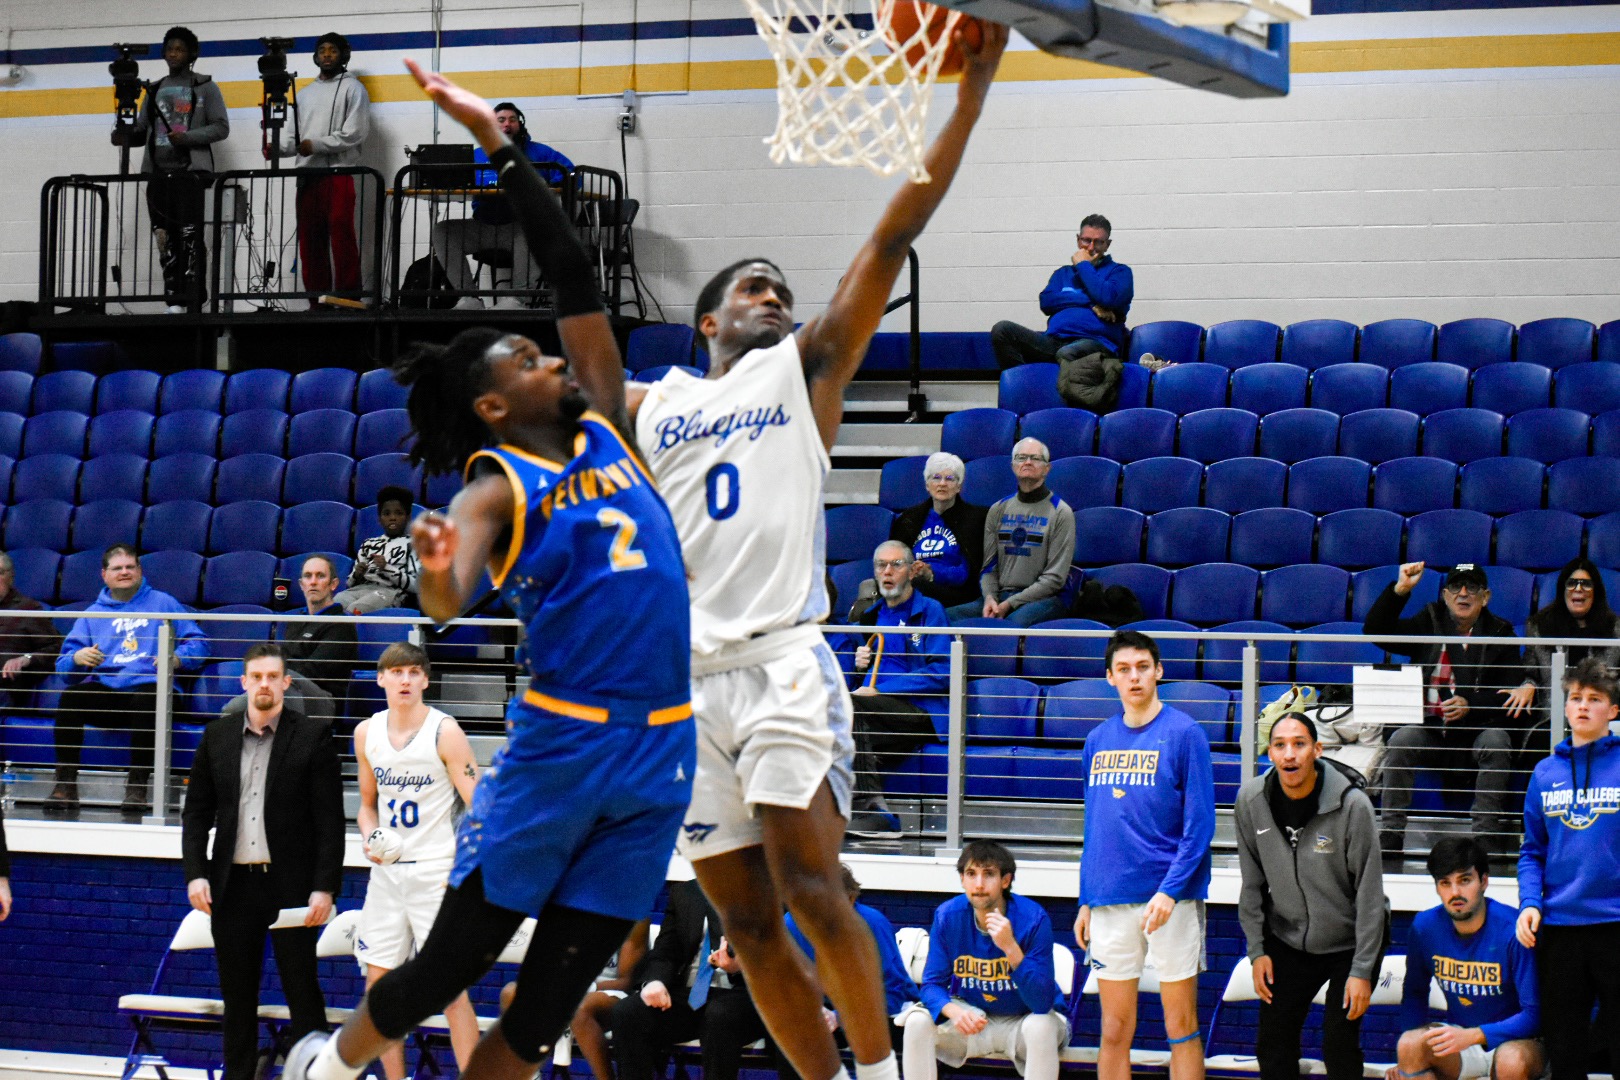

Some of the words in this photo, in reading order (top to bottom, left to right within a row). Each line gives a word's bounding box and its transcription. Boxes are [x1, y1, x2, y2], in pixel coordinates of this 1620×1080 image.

[653, 403, 791, 454] Bluejays
[705, 462, 740, 521] 0
[596, 507, 648, 572] 2
[1093, 753, 1156, 771] BLUEJAYS
[373, 766, 435, 793] Bluejays
[1089, 773, 1156, 787] BASKETBALL
[1541, 789, 1574, 807] TABOR
[387, 798, 420, 828] 10
[956, 957, 1010, 978] BLUEJAY
[1434, 959, 1498, 983] BLUEJAYS
